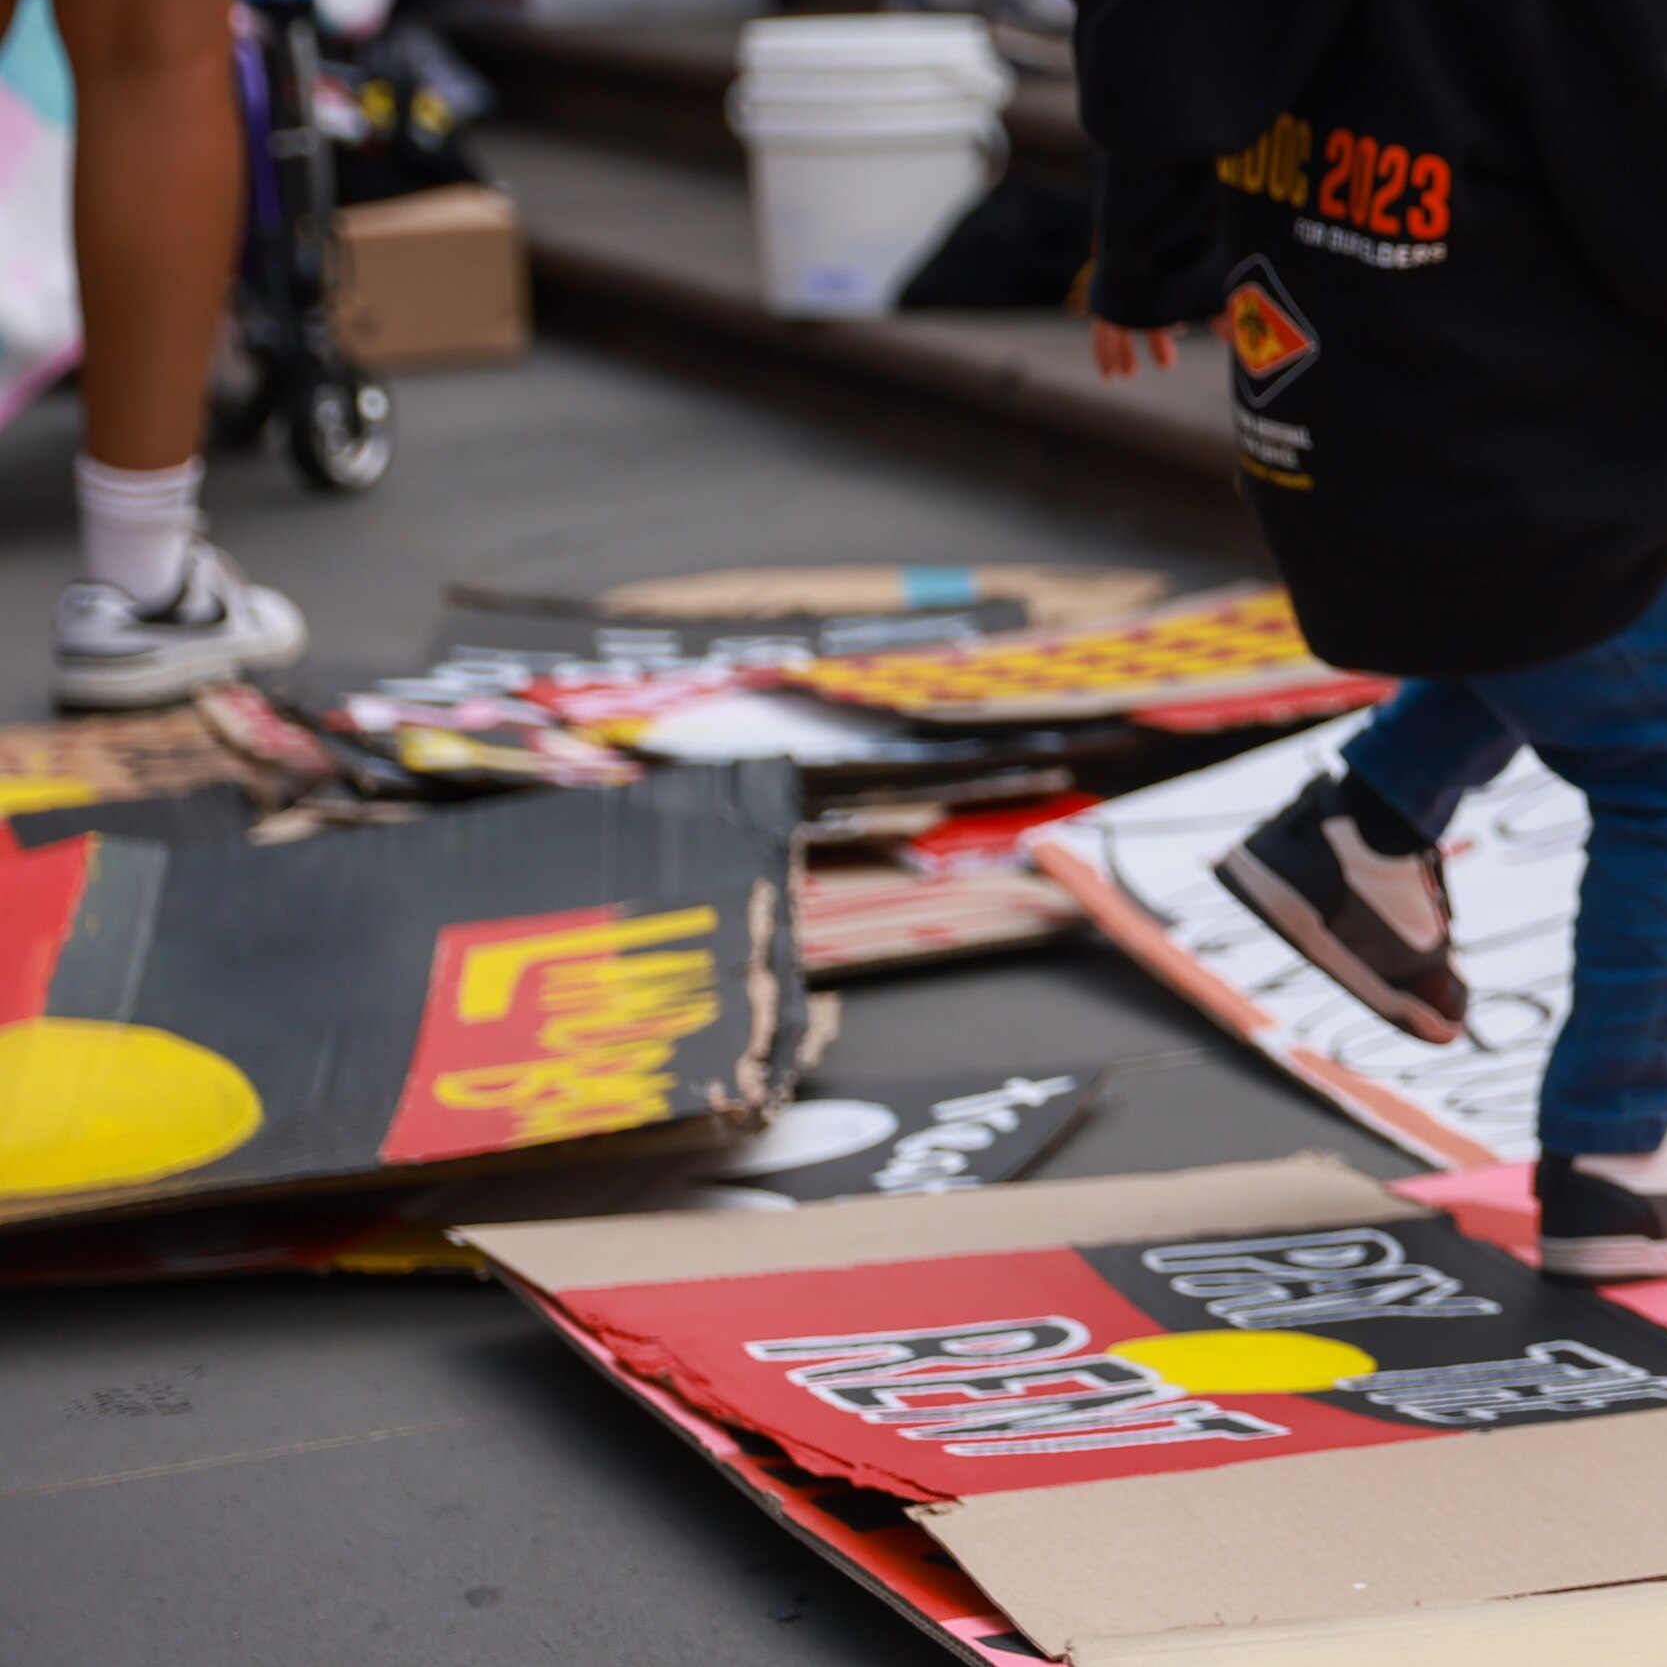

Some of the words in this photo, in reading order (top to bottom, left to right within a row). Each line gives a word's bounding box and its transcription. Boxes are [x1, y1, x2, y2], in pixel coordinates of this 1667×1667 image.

[1318, 127, 1451, 241] 2023
[1142, 1227, 1502, 1330] PAY
[744, 1315, 1292, 1456] RENT
